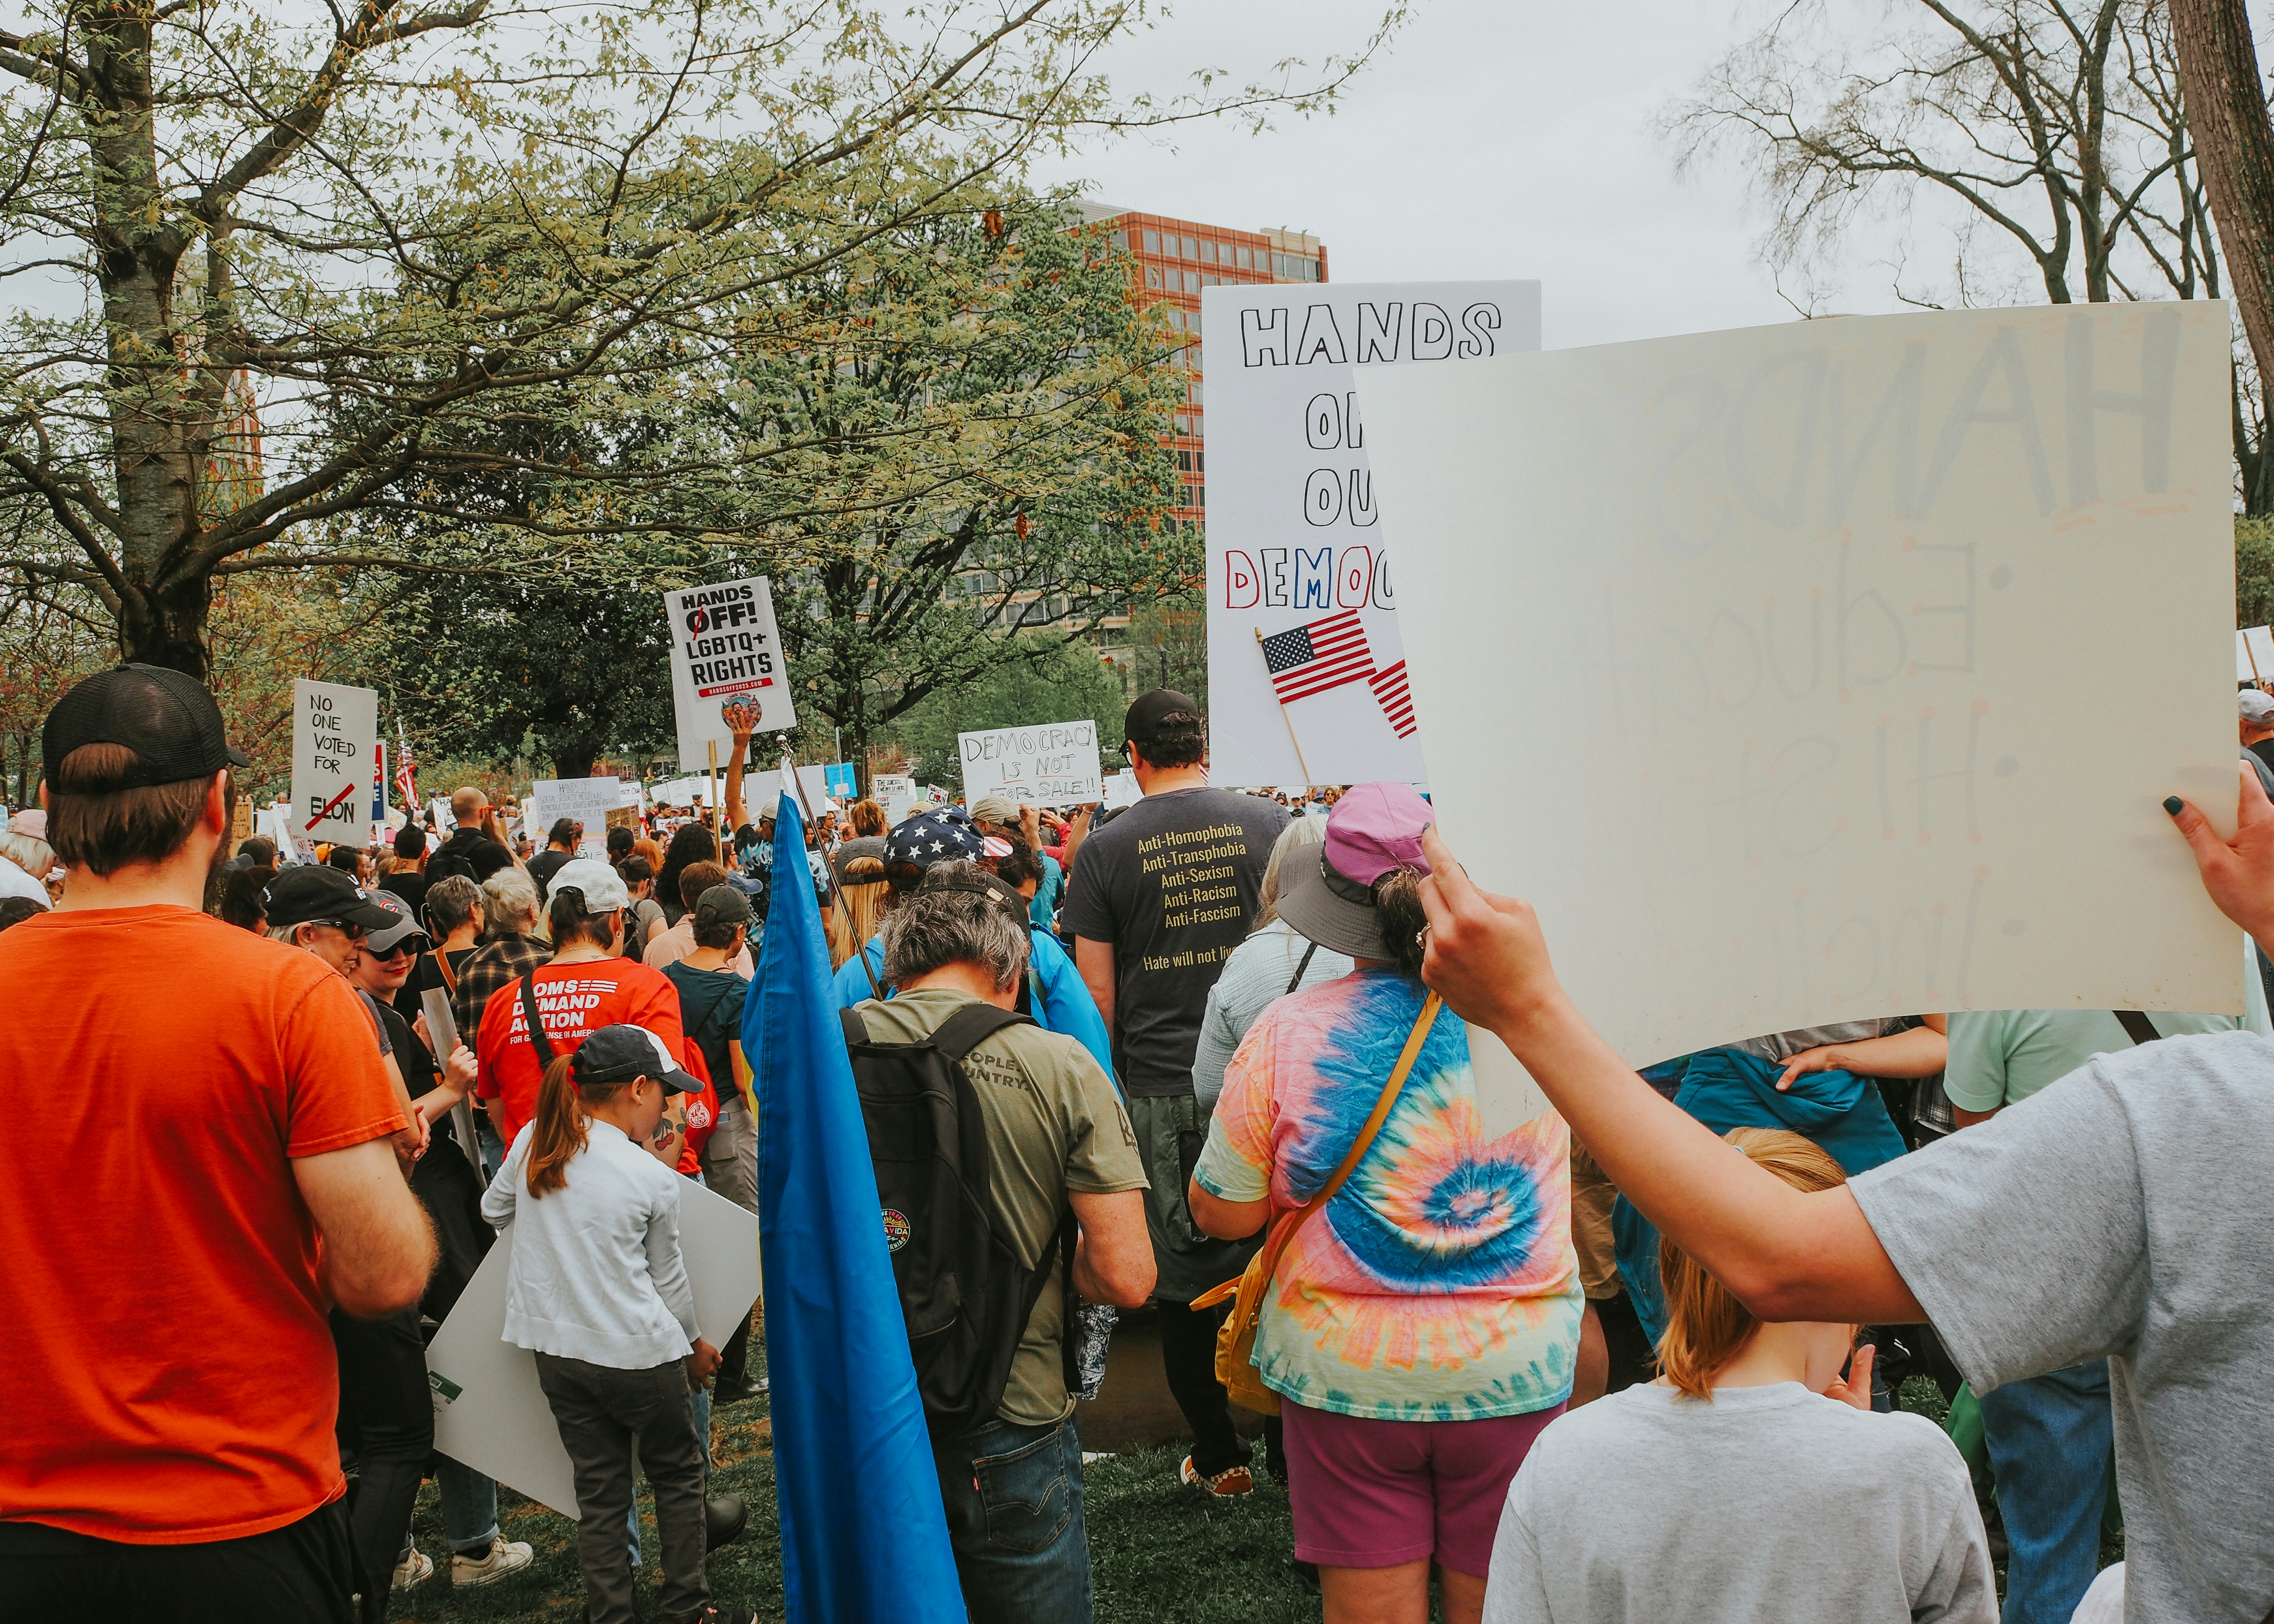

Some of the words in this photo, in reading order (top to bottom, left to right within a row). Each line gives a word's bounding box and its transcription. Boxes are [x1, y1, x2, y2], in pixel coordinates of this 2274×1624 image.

[1240, 302, 1501, 368] HANDS
[1304, 468, 1378, 527] OU
[1225, 546, 1396, 610] DEMOC
[681, 585, 753, 610] HANDS
[686, 601, 758, 634] OFF!
[686, 632, 767, 660] LGBTQ+
[690, 652, 772, 686] RIGHTS
[311, 695, 332, 711] NO
[312, 713, 341, 731] ONE
[314, 733, 356, 757] VOTED
[965, 725, 1091, 762] DEMOCRACY
[315, 755, 340, 774] FOR
[1002, 762, 1020, 780] IS
[1036, 754, 1076, 775] NOT
[1039, 777, 1095, 798] SALE!!
[311, 796, 354, 823] ELON
[1138, 823, 1243, 854] Anti-Homophobia
[1143, 842, 1247, 873] Anti-Transphobia
[1161, 865, 1234, 889] Anti-Sexism
[1164, 885, 1237, 909] Anti-Racism
[1165, 906, 1240, 928] Anti-Fascism
[1143, 955, 1169, 971] Hate
[1173, 951, 1193, 967] will
[1197, 948, 1216, 963] not
[512, 994, 600, 1016] DMAND
[510, 1035, 522, 1045] FOR
[546, 1031, 563, 1039] ENSE
[964, 1052, 1021, 1072] OPLE.
[964, 1066, 1029, 1091] UNTRY.
